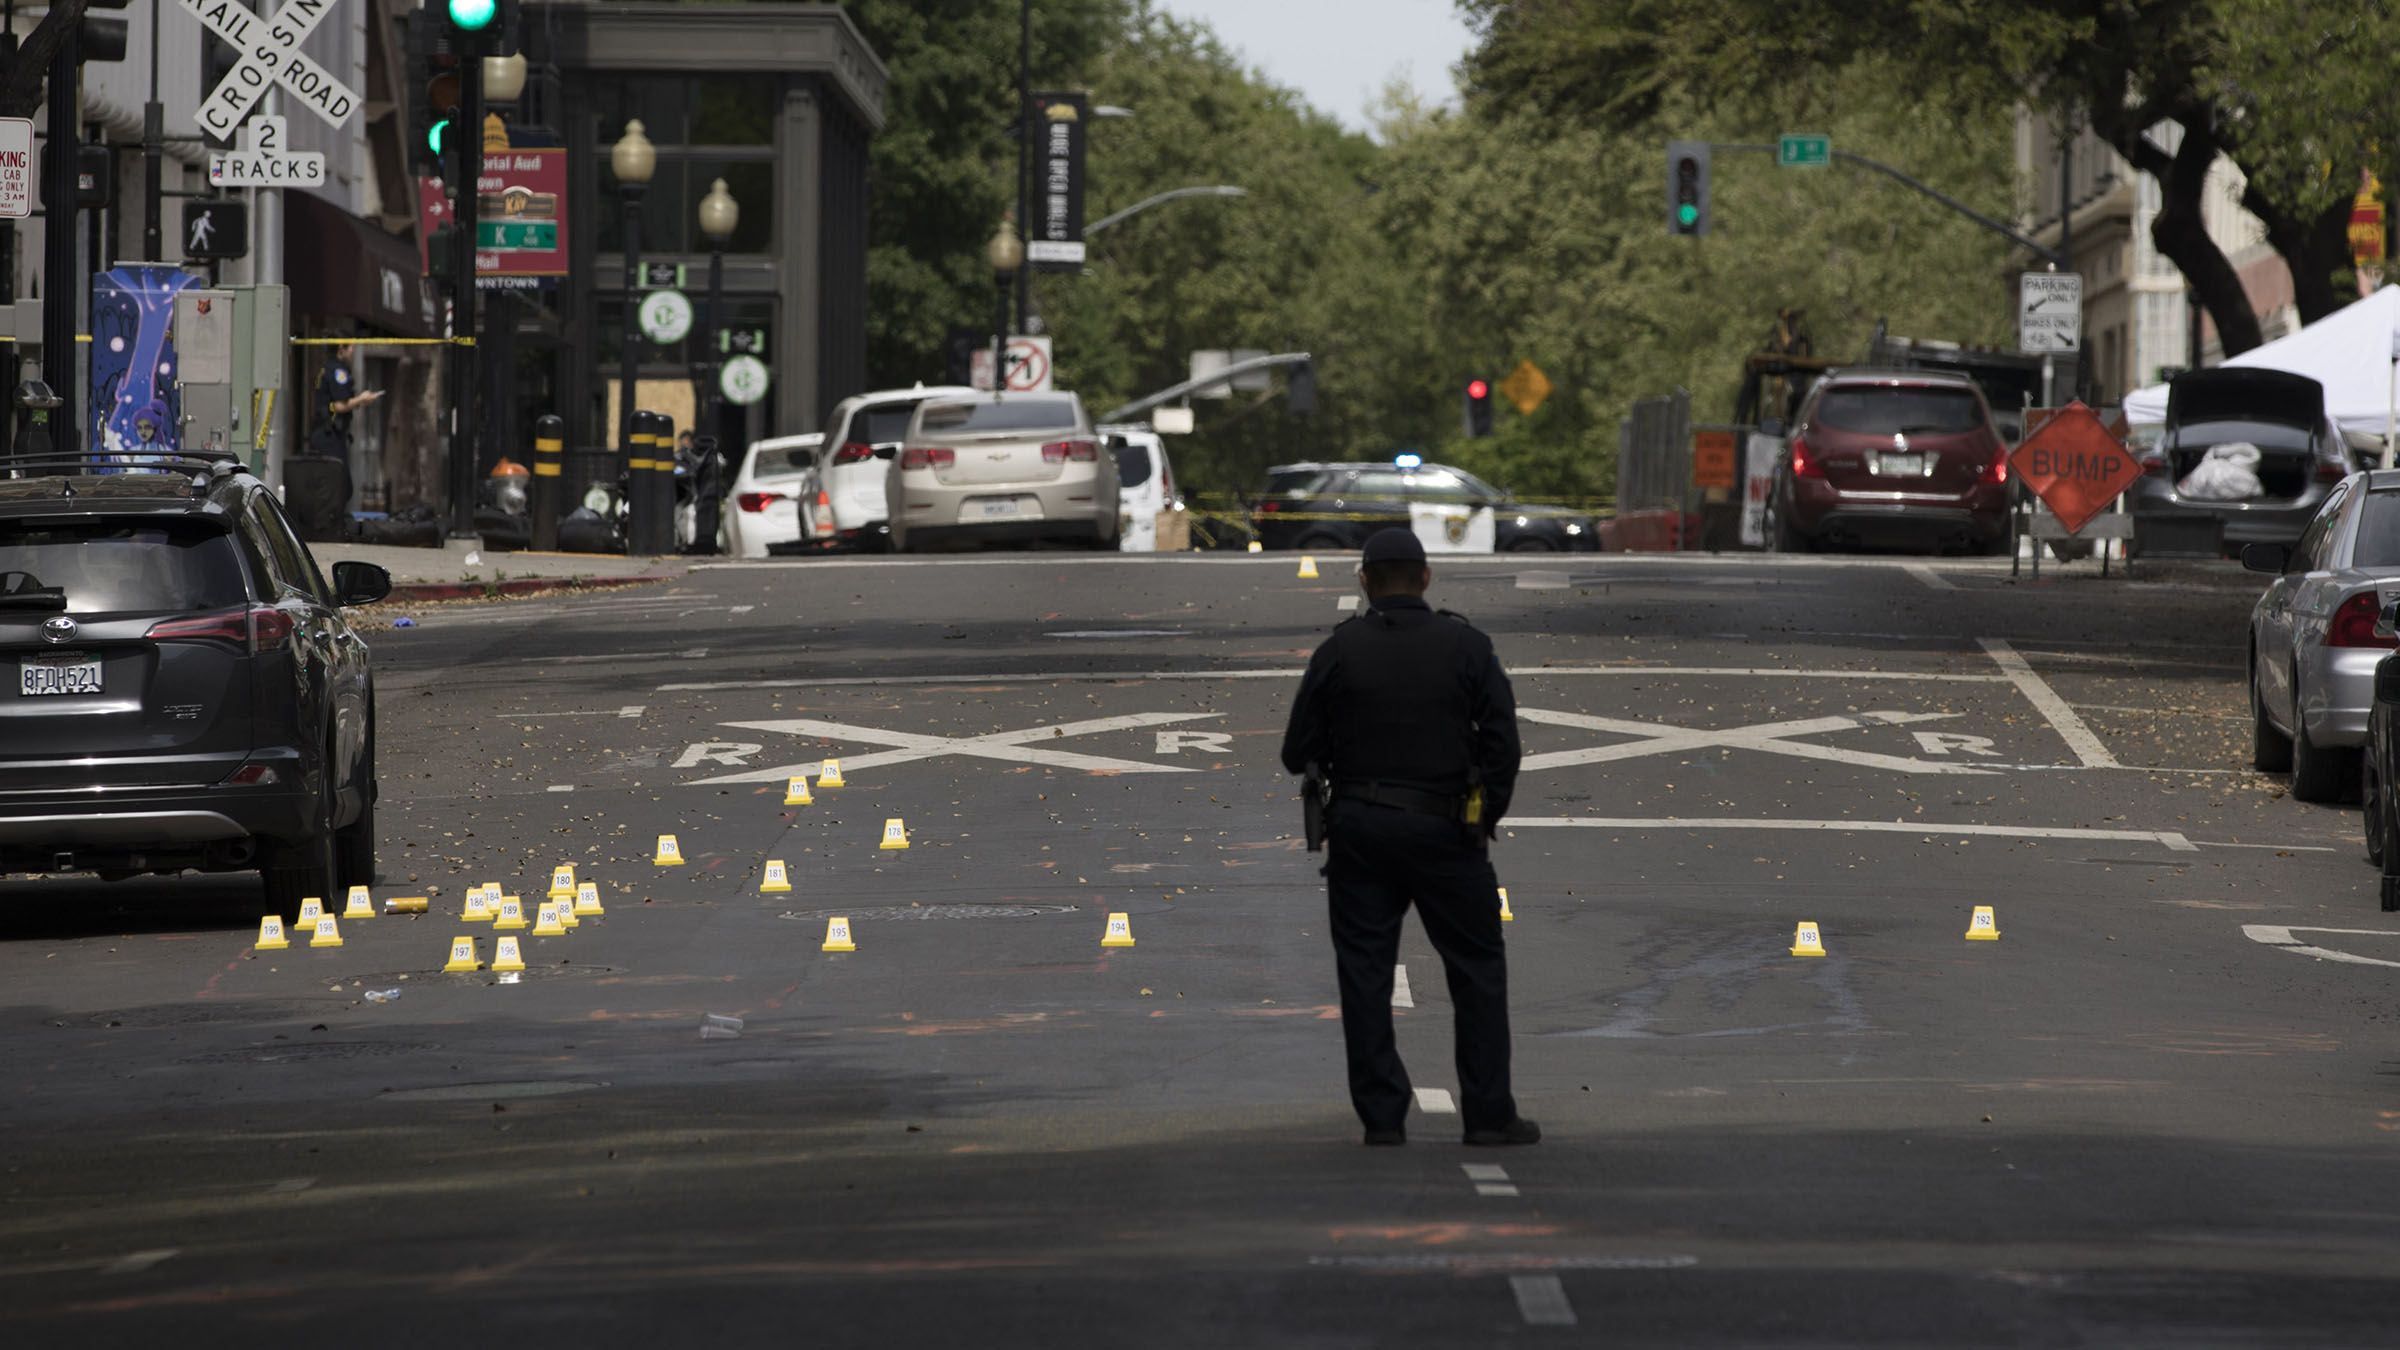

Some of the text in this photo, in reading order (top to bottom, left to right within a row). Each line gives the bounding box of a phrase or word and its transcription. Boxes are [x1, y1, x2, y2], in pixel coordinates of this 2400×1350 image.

[283, 59, 350, 119] ROAD
[259, 125, 276, 148] 2
[514, 156, 542, 171] Aud
[4, 169, 21, 180] CAB
[215, 160, 319, 179] TRACKS
[5, 182, 24, 192] ONLY
[12, 193, 25, 201] AM
[495, 226, 506, 244] K
[2024, 278, 2079, 291] PARKING
[2047, 293, 2077, 303] ONLY
[2032, 450, 2122, 482] BUMP
[22, 685, 101, 695] MAITA
[1155, 730, 1234, 754] R
[669, 742, 764, 768] R
[824, 767, 837, 776] 176
[792, 784, 804, 793] 177
[888, 827, 901, 836] 178
[661, 842, 675, 852] 179
[768, 869, 782, 878] 181
[556, 875, 570, 885] 180
[485, 892, 499, 901] 184
[581, 891, 595, 901] 185
[470, 897, 484, 907] 186
[304, 906, 318, 916] 187
[503, 905, 517, 915] 189
[559, 904, 570, 914] 88
[541, 912, 556, 922] 190
[1976, 915, 1990, 925] 192
[264, 925, 279, 935] 199
[318, 923, 334, 932] 198
[831, 927, 846, 937] 195
[1111, 922, 1126, 932] 194
[1801, 931, 1816, 941] 193
[455, 947, 469, 957] 197
[500, 945, 515, 955] 196
